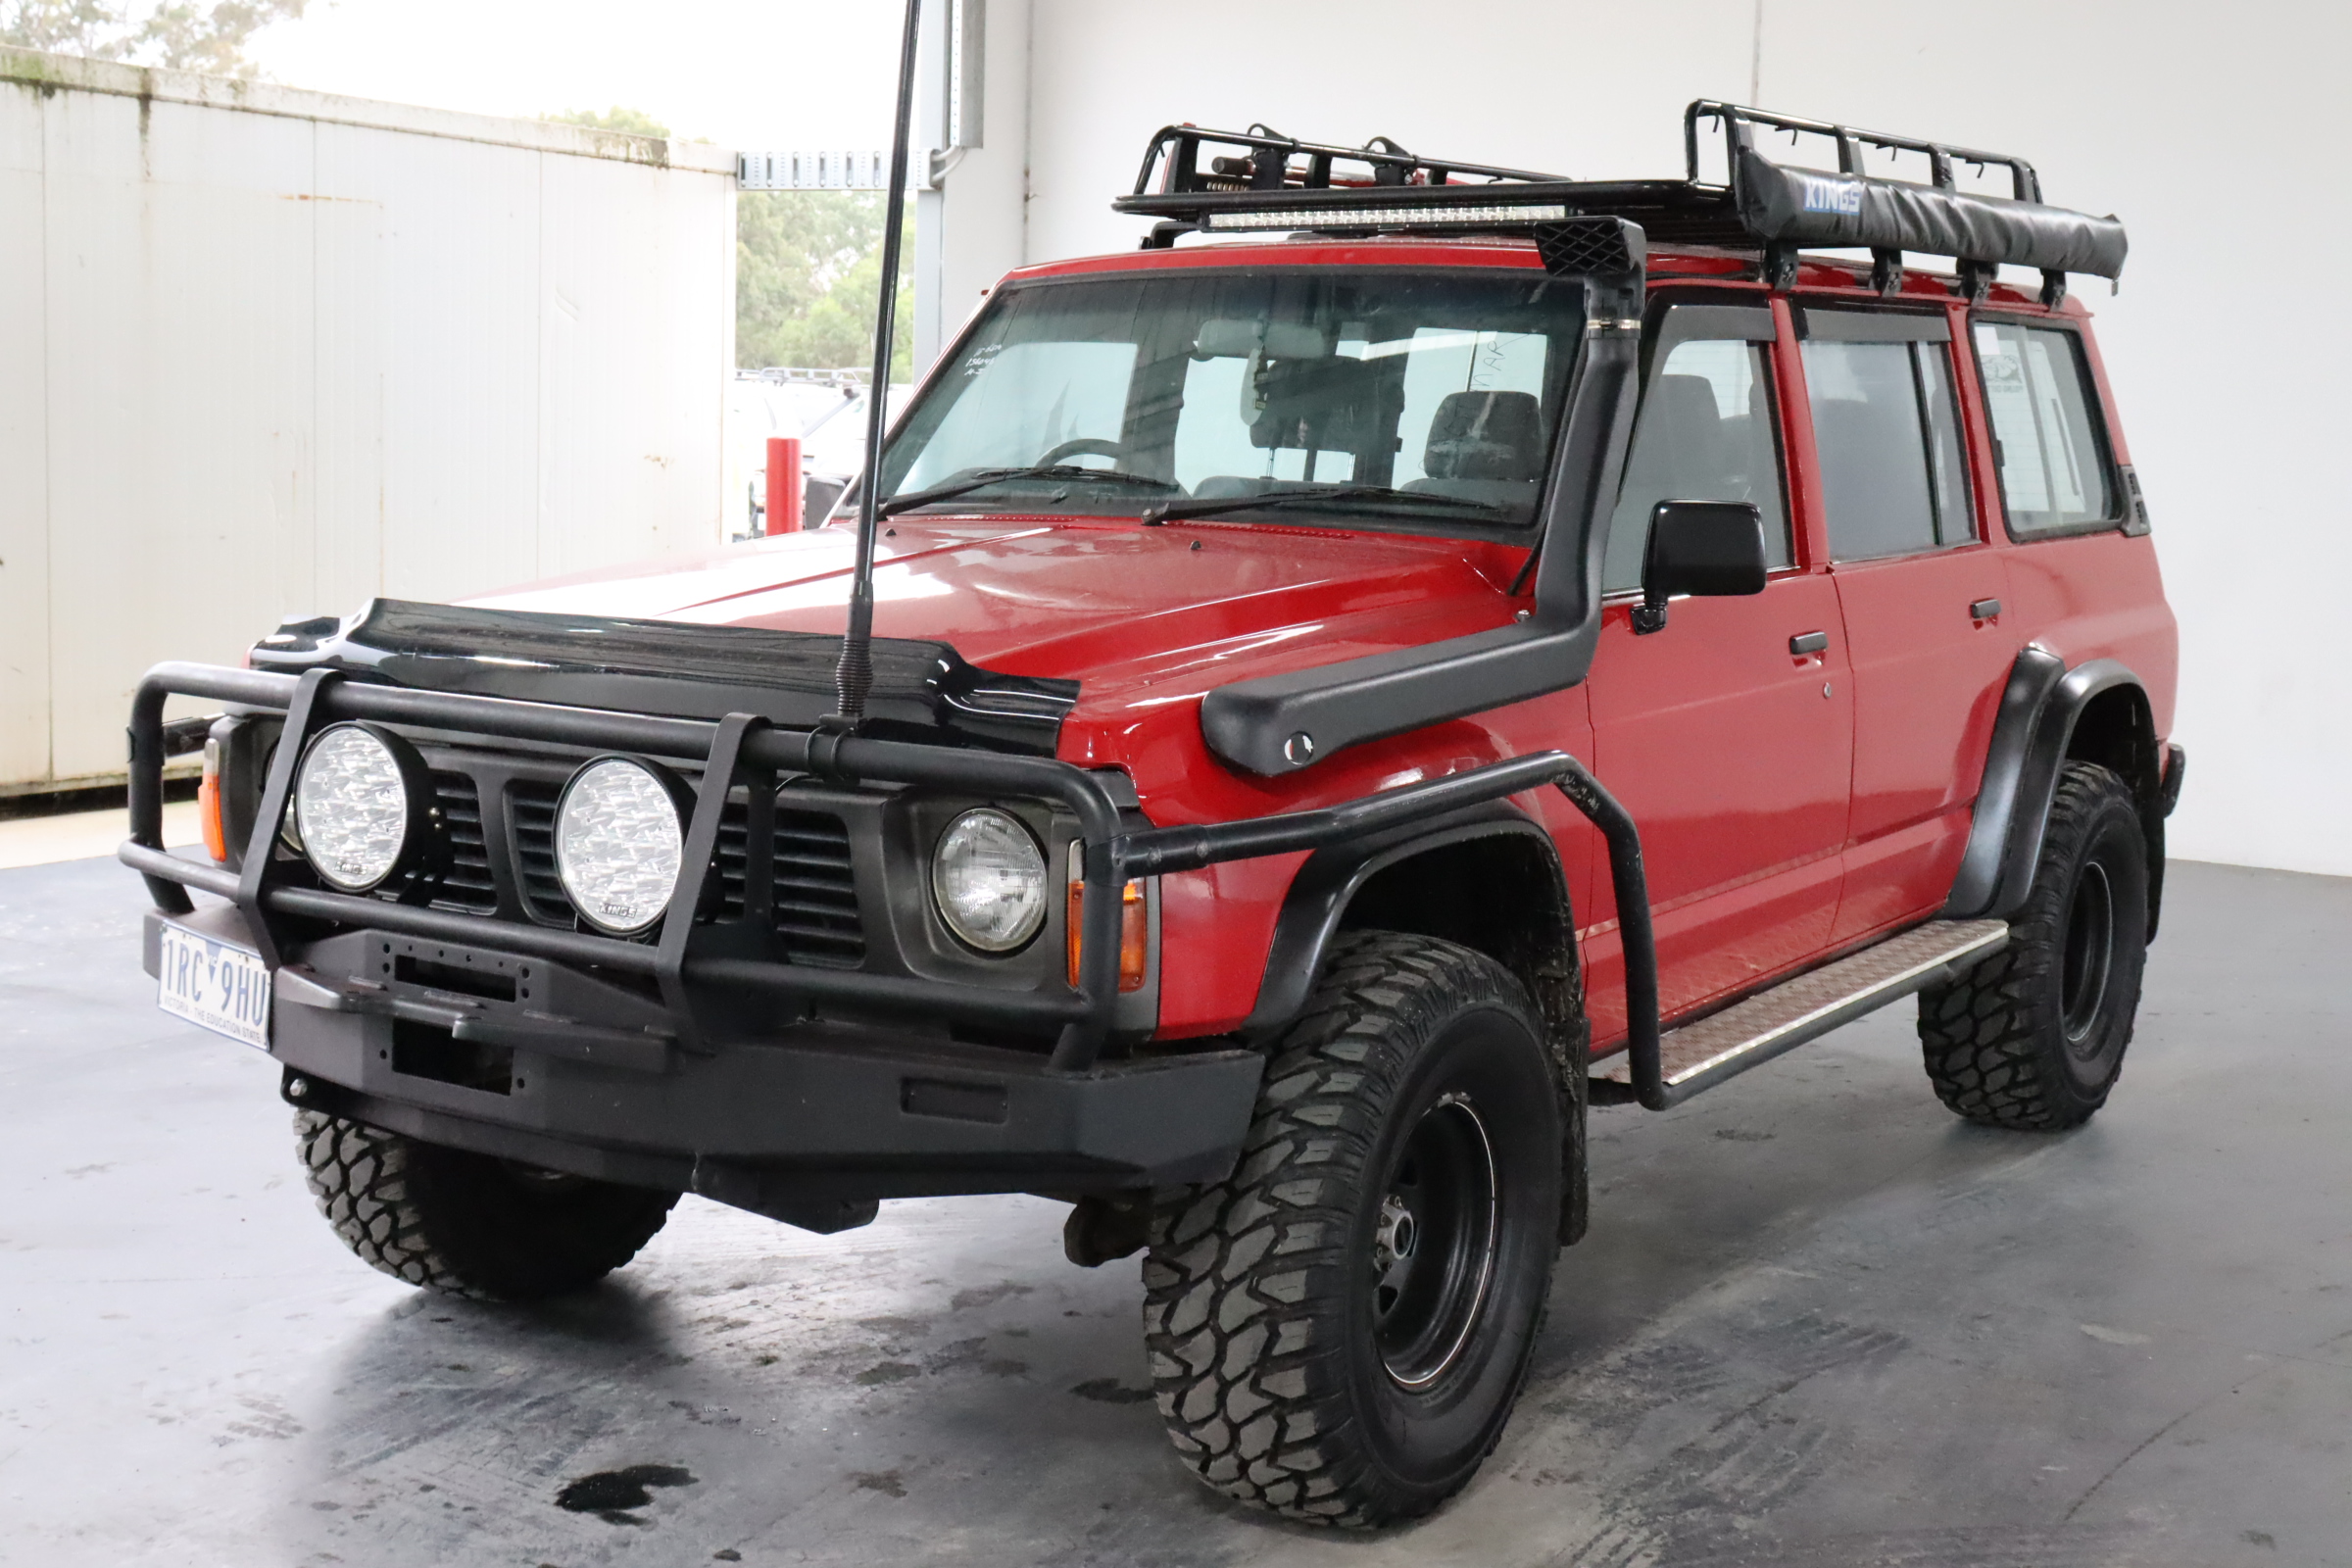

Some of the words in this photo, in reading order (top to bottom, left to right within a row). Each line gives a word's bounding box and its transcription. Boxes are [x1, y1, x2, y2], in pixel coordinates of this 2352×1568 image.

[1805, 178, 1861, 213] KINGS
[599, 903, 637, 918] KINGS
[168, 939, 203, 1002] 1RC
[220, 960, 267, 1027] 9HU
[164, 995, 189, 1013] VICTORIA
[194, 1006, 206, 1021] THE
[207, 1012, 241, 1036] EDUCATION
[242, 1026, 262, 1044] STATE
